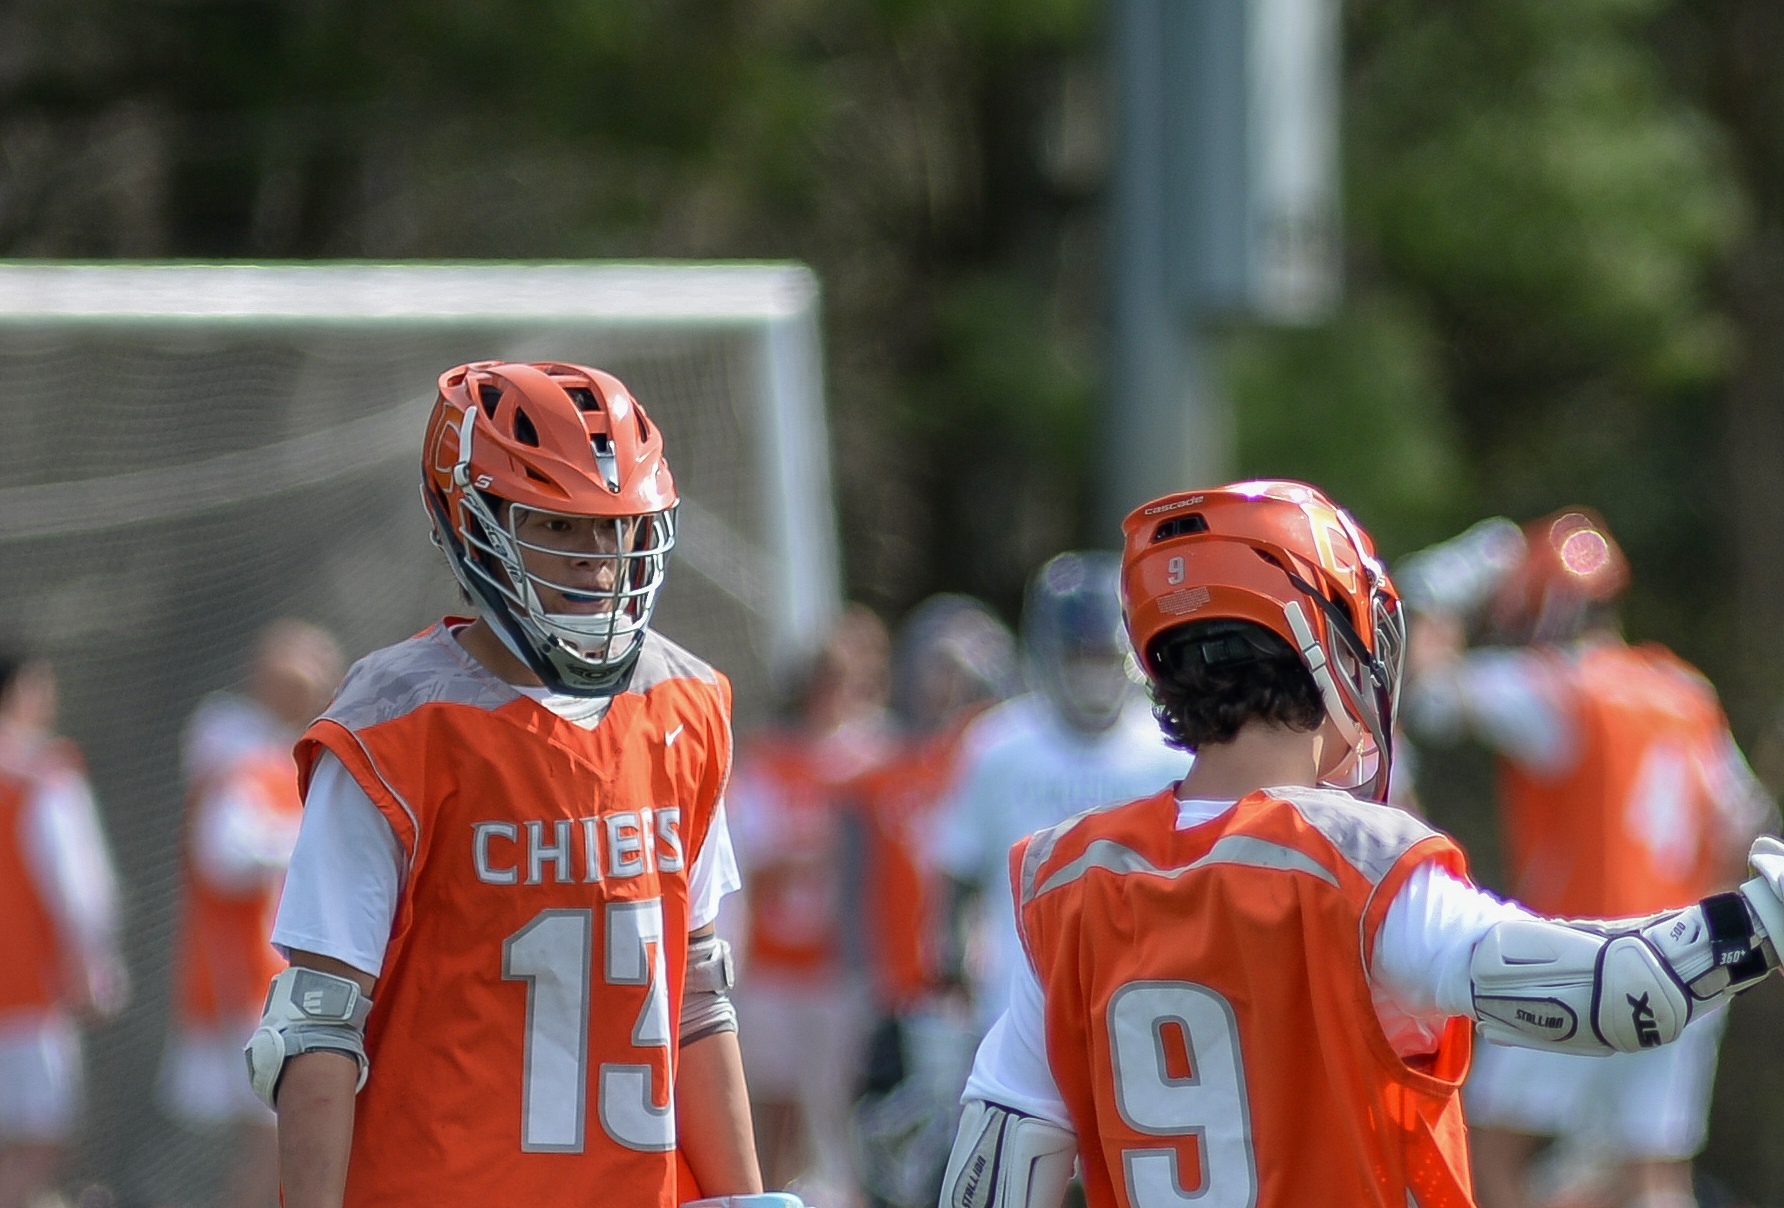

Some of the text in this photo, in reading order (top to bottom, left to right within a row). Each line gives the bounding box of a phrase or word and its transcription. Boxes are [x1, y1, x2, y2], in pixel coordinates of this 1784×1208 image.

[1144, 495, 1204, 515] cascade
[1167, 556, 1185, 585] 9
[471, 806, 684, 886] CHIEFS
[1669, 921, 1687, 942] 500
[501, 895, 677, 1154] 13
[1514, 1008, 1565, 1030] STALLION
[1626, 991, 1663, 1049] STX
